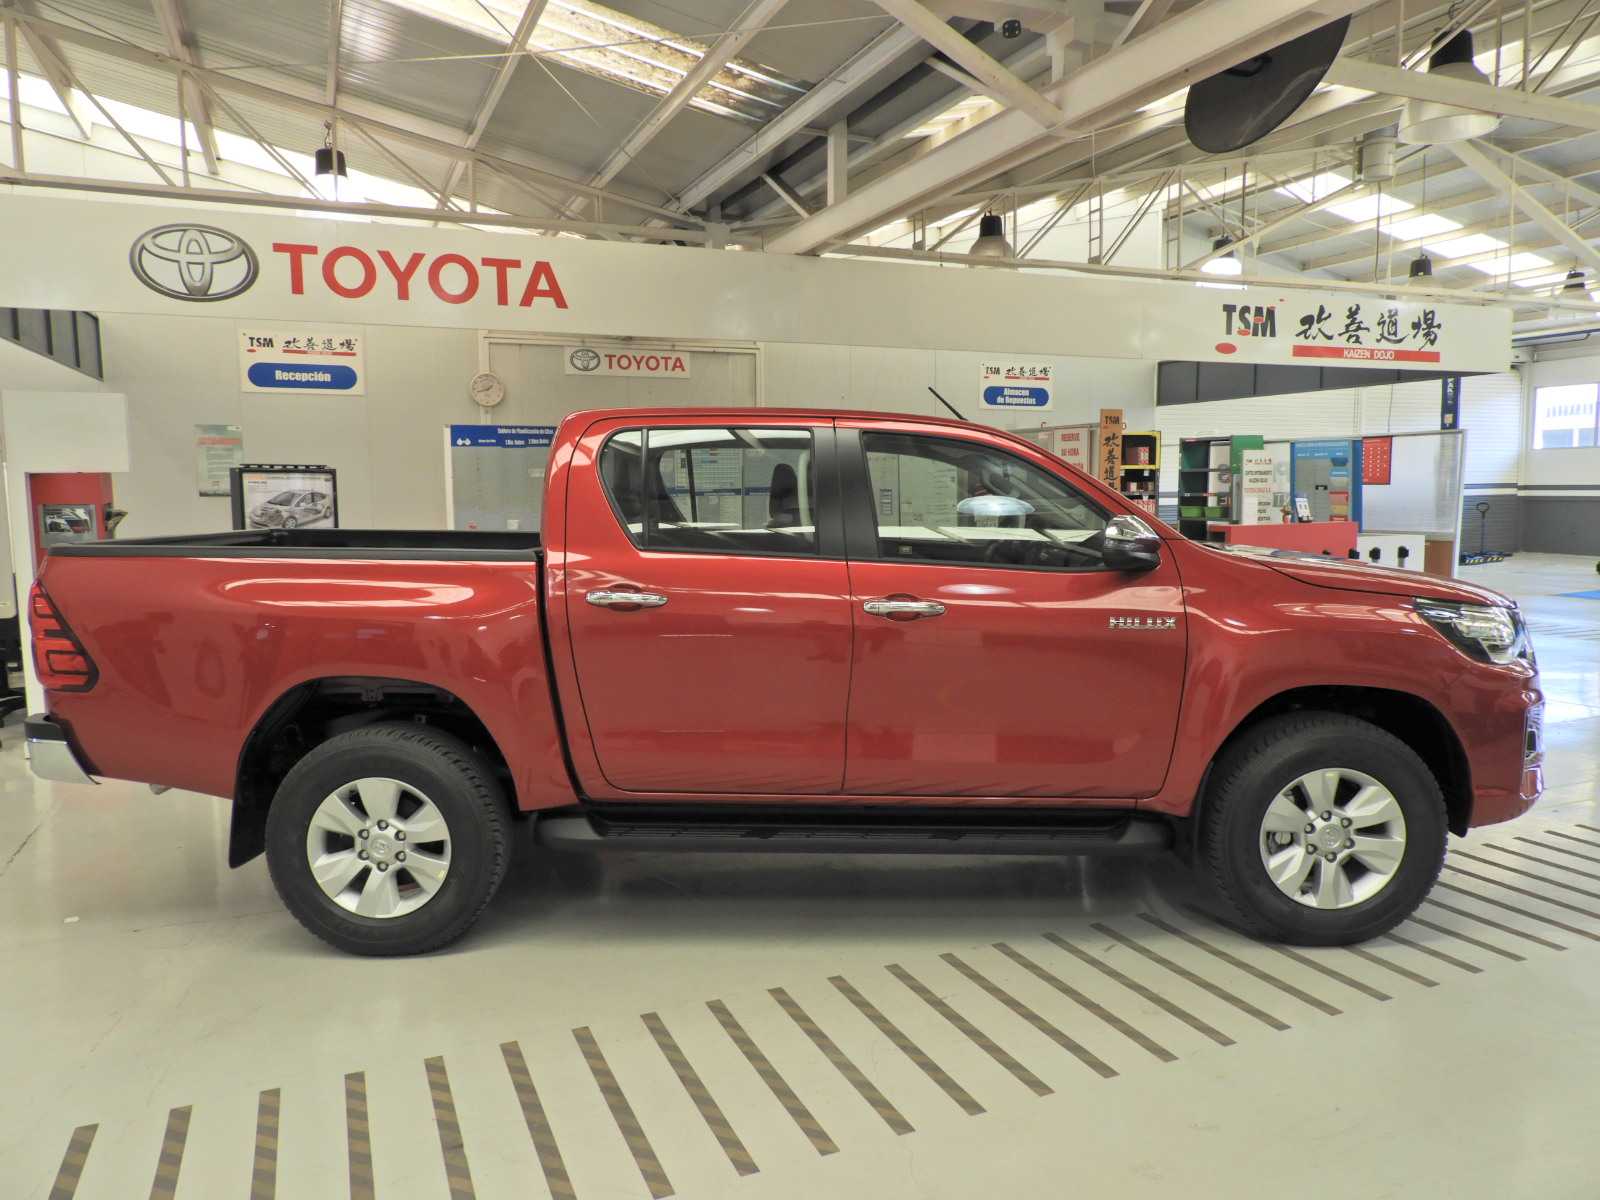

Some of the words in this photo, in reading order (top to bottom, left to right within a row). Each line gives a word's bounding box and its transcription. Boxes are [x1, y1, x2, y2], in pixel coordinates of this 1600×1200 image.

[272, 242, 569, 310] TOYOTA
[1222, 303, 1277, 338] TSM
[1295, 303, 1442, 352] 改善道場
[248, 336, 275, 348] TSM
[282, 336, 358, 352] 改善道場
[1343, 348, 1371, 360] KAIZEN
[1373, 350, 1395, 361] DOJO
[604, 353, 686, 372] TOYOTA
[275, 369, 332, 383] Recepción
[985, 366, 1001, 375] TSM
[1005, 396, 1036, 406] Repuestos
[1104, 415, 1120, 425] TSM
[1109, 616, 1177, 630] HILUX
